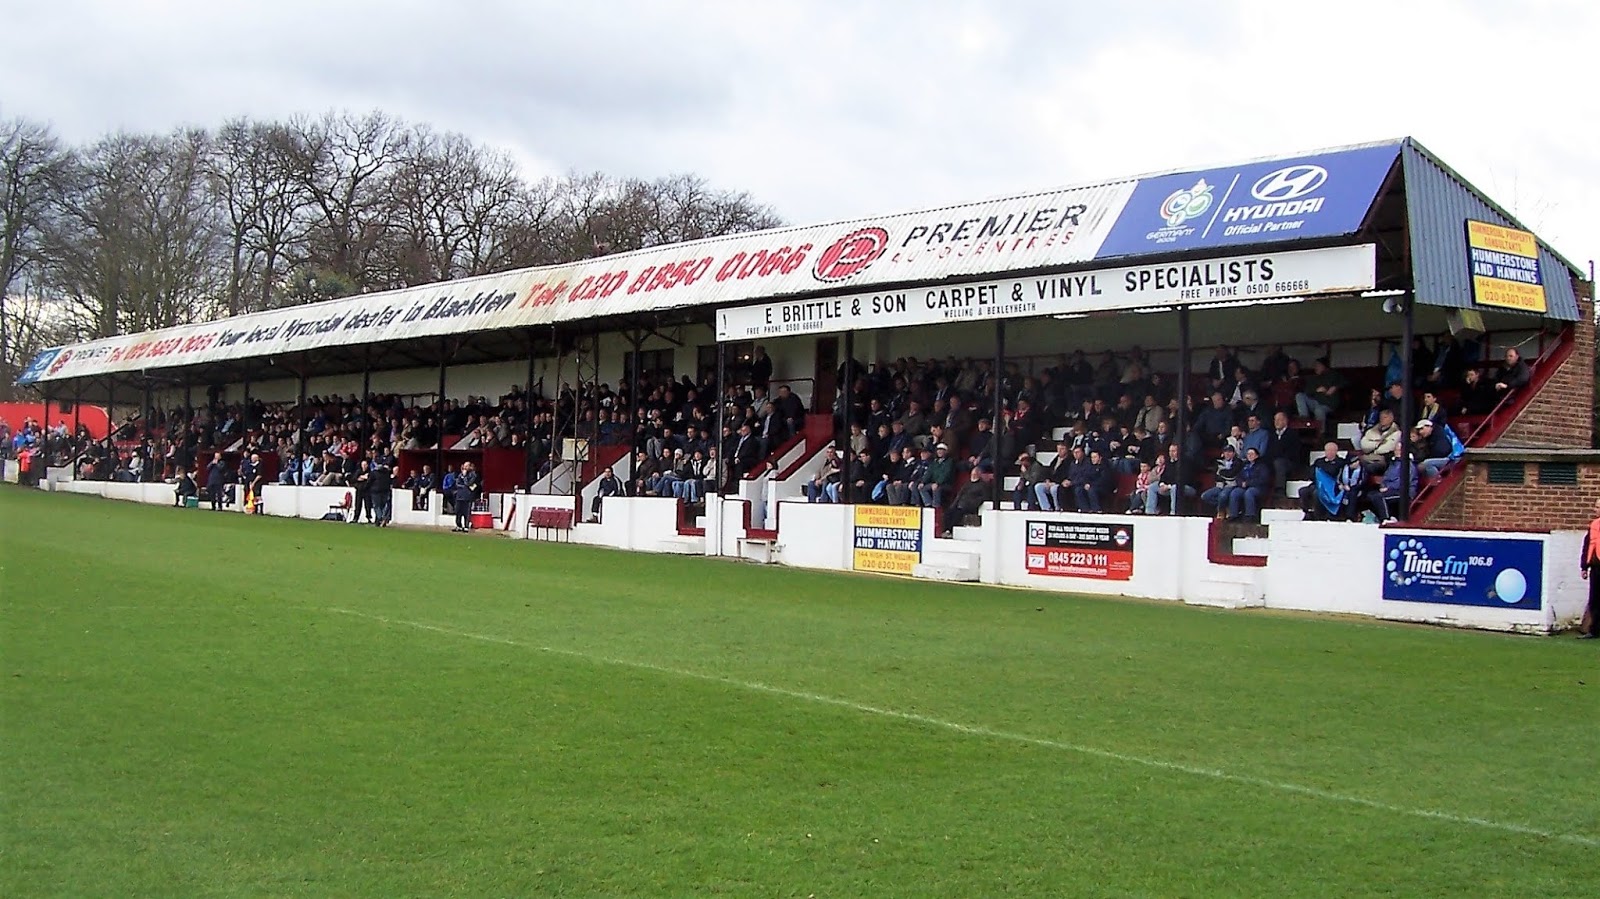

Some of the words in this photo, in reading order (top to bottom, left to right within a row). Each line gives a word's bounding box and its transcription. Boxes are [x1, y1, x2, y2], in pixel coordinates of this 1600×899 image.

[1223, 197, 1325, 222] HYUNDAI
[901, 204, 1088, 247] PREMIER
[1146, 227, 1195, 240] GERMANY
[1223, 222, 1262, 236] Official
[1263, 220, 1304, 233] Partner
[1472, 248, 1538, 271] HUMMERSTONE
[1474, 261, 1494, 276] AND
[1496, 266, 1537, 284] HAWKINS
[243, 319, 287, 344] local
[343, 305, 403, 331] dealer
[401, 301, 425, 322] in
[568, 269, 628, 303] 020
[627, 255, 714, 295] 8850
[715, 243, 813, 282] 0066
[765, 307, 772, 324] E
[782, 299, 842, 323] BRITTLE
[851, 298, 862, 316] &
[872, 293, 907, 314] SON
[926, 284, 999, 310] CARPET
[1011, 282, 1023, 302] &
[1036, 275, 1102, 300] VINYL
[1125, 258, 1275, 292] SPECIALISTS
[1181, 288, 1201, 299] FREE
[1209, 286, 1238, 297] PHONE
[1246, 283, 1270, 295] 0500
[1275, 279, 1310, 292] 666668
[944, 307, 974, 318] WELLING
[987, 302, 1037, 316] BEXLEYHEATH
[746, 326, 760, 336] FREE
[763, 325, 781, 334] PHONE
[856, 527, 920, 541] HUMMERSTONE
[856, 537, 874, 548] AND
[877, 538, 917, 551] HAWKINS
[1048, 551, 1069, 564] 0845
[1070, 553, 1086, 565] 222
[1086, 554, 1093, 566] 0
[1093, 554, 1108, 567] 111
[1468, 556, 1494, 567] 106.8
